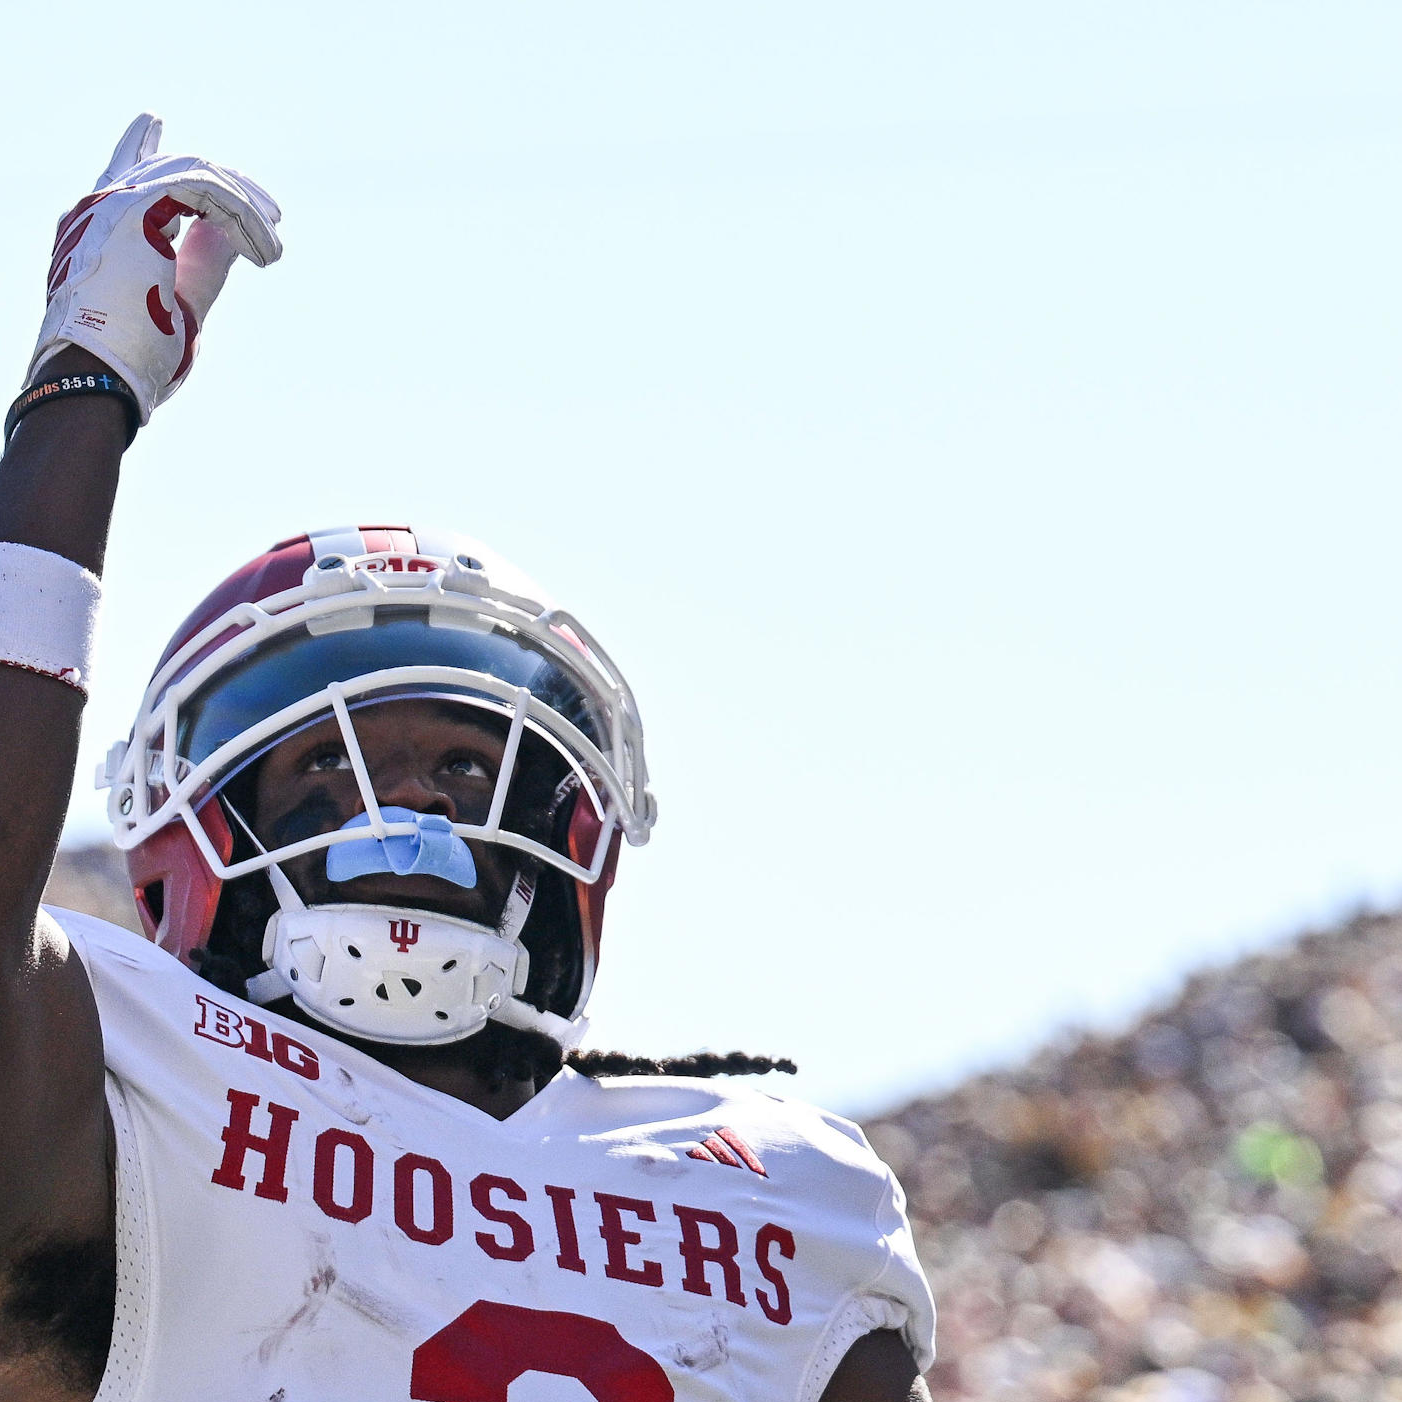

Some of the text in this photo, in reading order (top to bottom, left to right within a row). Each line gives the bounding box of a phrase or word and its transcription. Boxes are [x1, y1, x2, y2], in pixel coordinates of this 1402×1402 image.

[14, 375, 96, 412] Proverbs 3:5-6
[211, 1088, 796, 1326] HOOSIERS
